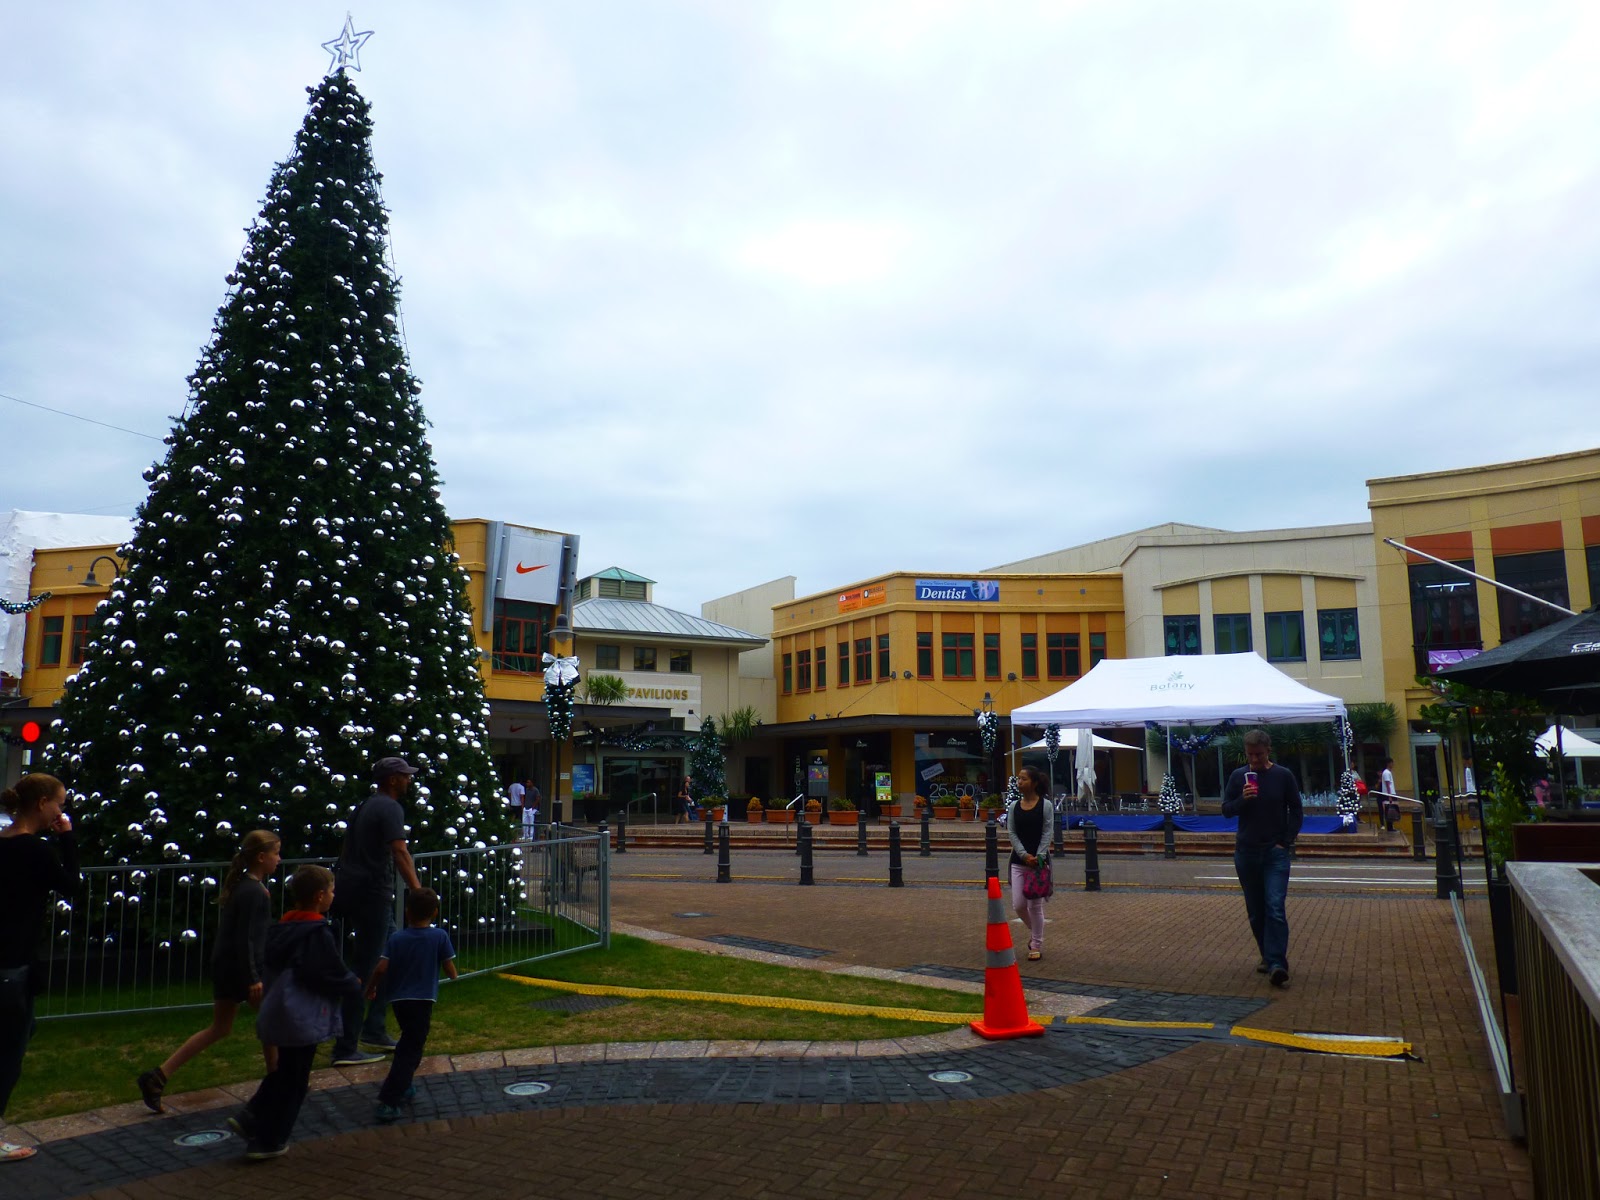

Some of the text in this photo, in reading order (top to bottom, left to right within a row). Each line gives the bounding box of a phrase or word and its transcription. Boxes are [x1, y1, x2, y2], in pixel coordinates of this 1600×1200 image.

[920, 587, 967, 600] Dentist
[1150, 682, 1195, 691] Botany
[628, 687, 689, 700] PAVILIONS
